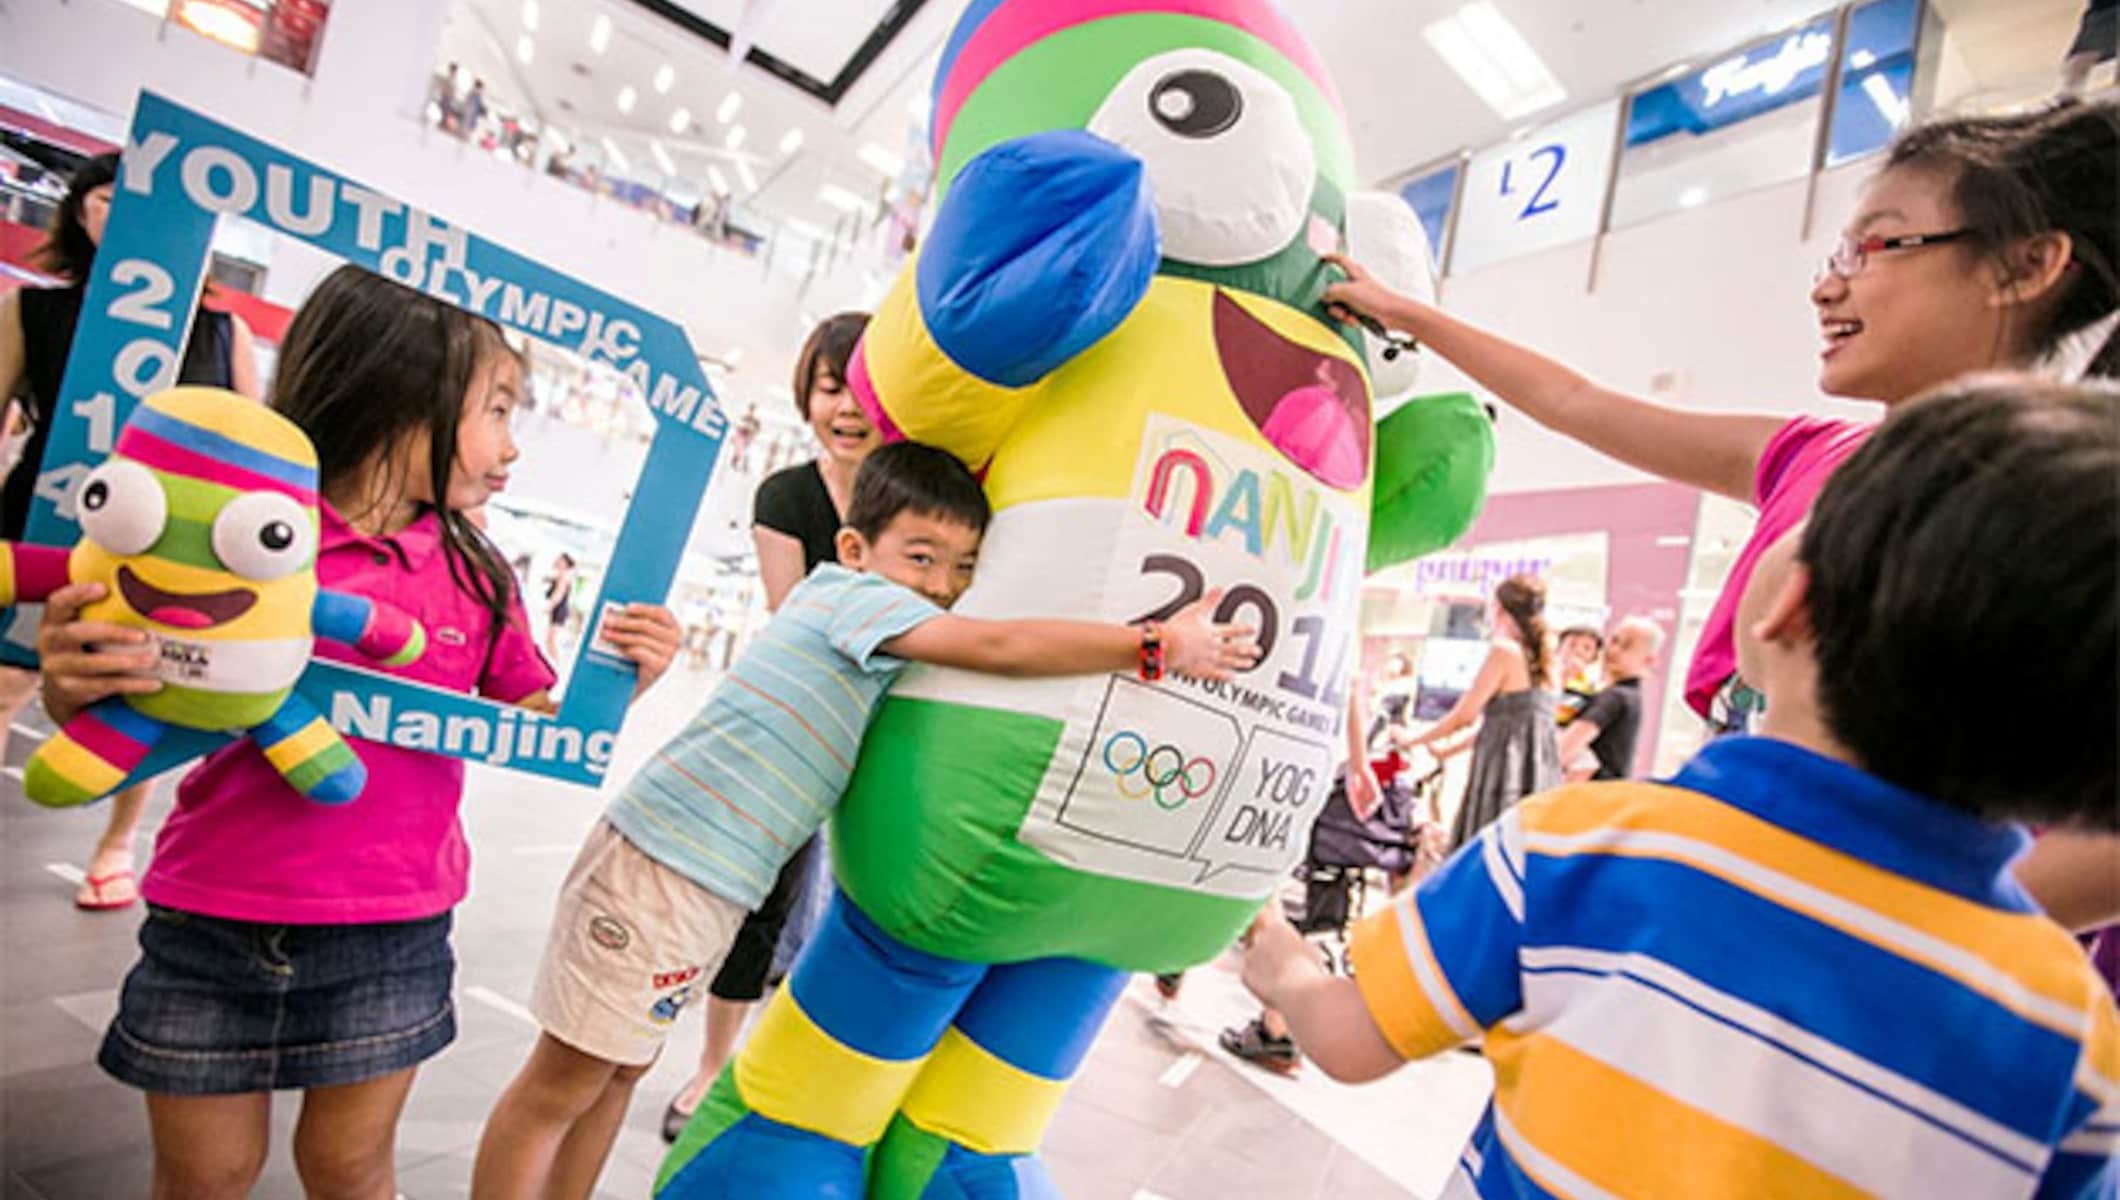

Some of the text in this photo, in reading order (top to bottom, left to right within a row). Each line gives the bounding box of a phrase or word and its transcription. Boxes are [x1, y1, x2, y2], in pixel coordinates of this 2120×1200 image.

[121, 131, 468, 273] YOUTH
[380, 245, 641, 359] OLYMPIC
[1144, 449, 1344, 603] NANJI
[330, 690, 617, 775] Nanjing
[1201, 676, 1287, 720] OLYMPIC
[1255, 757, 1316, 808] YOG
[1224, 804, 1293, 851] DNA
